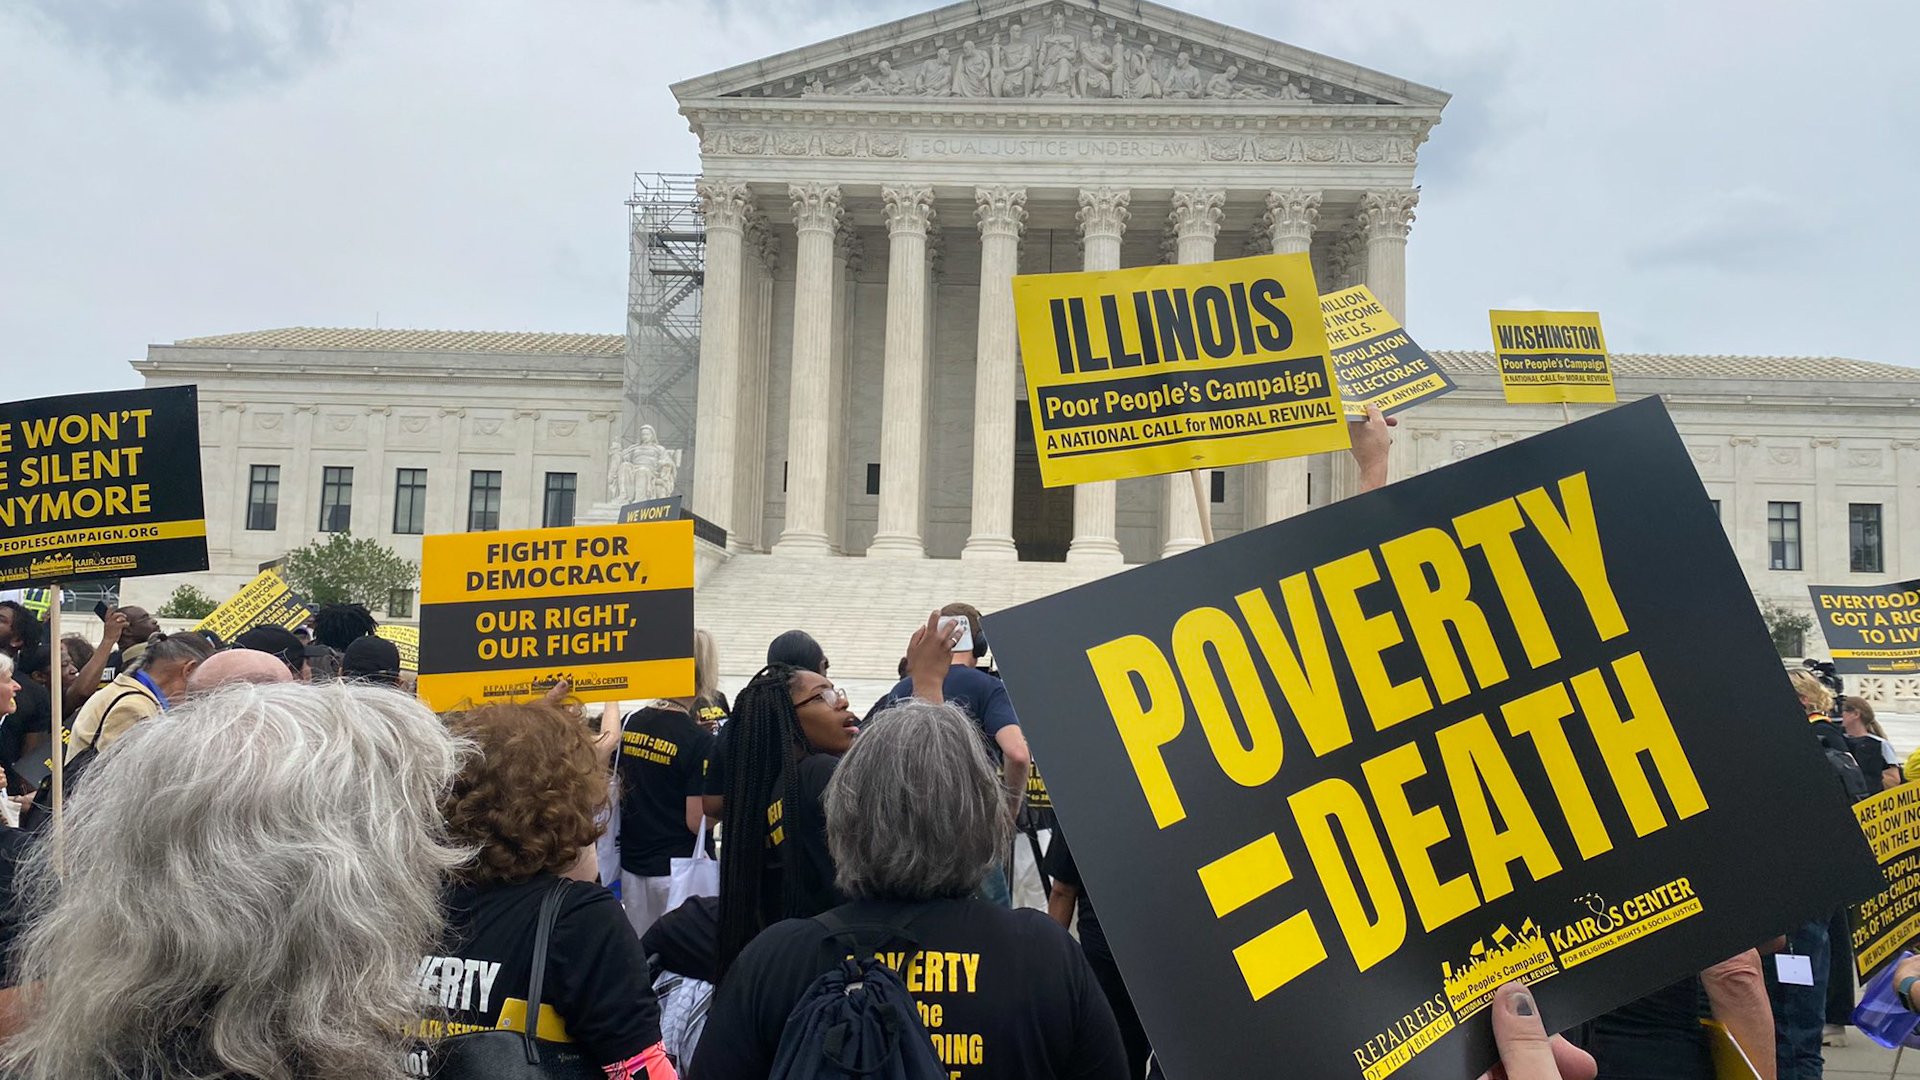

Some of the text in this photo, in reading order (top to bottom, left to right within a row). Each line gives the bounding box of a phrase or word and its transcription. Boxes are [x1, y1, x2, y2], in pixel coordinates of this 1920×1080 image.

[921, 139, 1189, 156] EQUAL JUSTICE UNDER LAW
[1050, 279, 1293, 374] ILLINOIS
[1333, 302, 1383, 325] INCOME
[1347, 322, 1376, 337] U.S.
[1497, 325, 1601, 349] WASHINGTON
[1331, 333, 1409, 367] POPULATION
[1503, 357, 1605, 371] Poor People's Campaign
[1340, 353, 1400, 381] CHILDREN
[1351, 358, 1430, 395] ELECTORATE
[1045, 396, 1099, 420] Poor
[1104, 381, 1202, 413] People's
[1205, 370, 1322, 401] Campaign
[1375, 396, 1392, 409] ENT
[1392, 379, 1436, 402] ANYMORE
[21, 409, 152, 449] WON'T
[1047, 435, 1057, 449] A
[1061, 426, 1139, 448] NATIONAL
[1142, 420, 1182, 438] CALL
[1186, 418, 1206, 432] for
[1209, 411, 1266, 430] MORAL
[1269, 402, 1335, 423] REVIVAL
[19, 446, 143, 487] SILENT
[0, 483, 151, 527] NYMORE
[626, 505, 671, 522] WE WON'T
[105, 554, 137, 565] CENTER
[487, 536, 629, 564] FIGHT FOR
[466, 561, 648, 592] DEMOCRACY,
[216, 606, 231, 619] ARE
[243, 575, 272, 599] MILLION
[219, 579, 280, 629] AND LOW INCOME
[1820, 590, 1920, 609] EVERYBOD
[274, 603, 303, 625] TORATE
[475, 603, 637, 633] OUR RIGHT,
[1830, 609, 1920, 627] GOT A RIG
[477, 630, 629, 661] OUR FIGHT
[1086, 471, 1629, 829] POVERTY
[1859, 627, 1920, 644] TO LIV
[602, 676, 628, 685] CENTER
[1860, 804, 1877, 825] ARE
[1878, 796, 1895, 816] 140
[1879, 812, 1901, 836] LOW
[1880, 838, 1890, 855] IN
[1891, 829, 1909, 849] THE
[1622, 876, 1695, 921] CENTER
[1889, 872, 1920, 900] CHILDR
[1563, 954, 1579, 965] FOR
[1579, 939, 1617, 958] RELIGIONS,
[1617, 928, 1642, 942] RIGHTS
[1648, 914, 1672, 929] SOCIAL
[1673, 902, 1699, 918] JUSTICE
[1869, 916, 1880, 936] OF
[1880, 906, 1895, 928] THE
[1450, 951, 1549, 1005] Poor People's Campaign
[1530, 963, 1558, 981] REVIVAL
[1353, 993, 1447, 1070] REPAIRERS
[1366, 1015, 1454, 1080] OF THE BREACH
